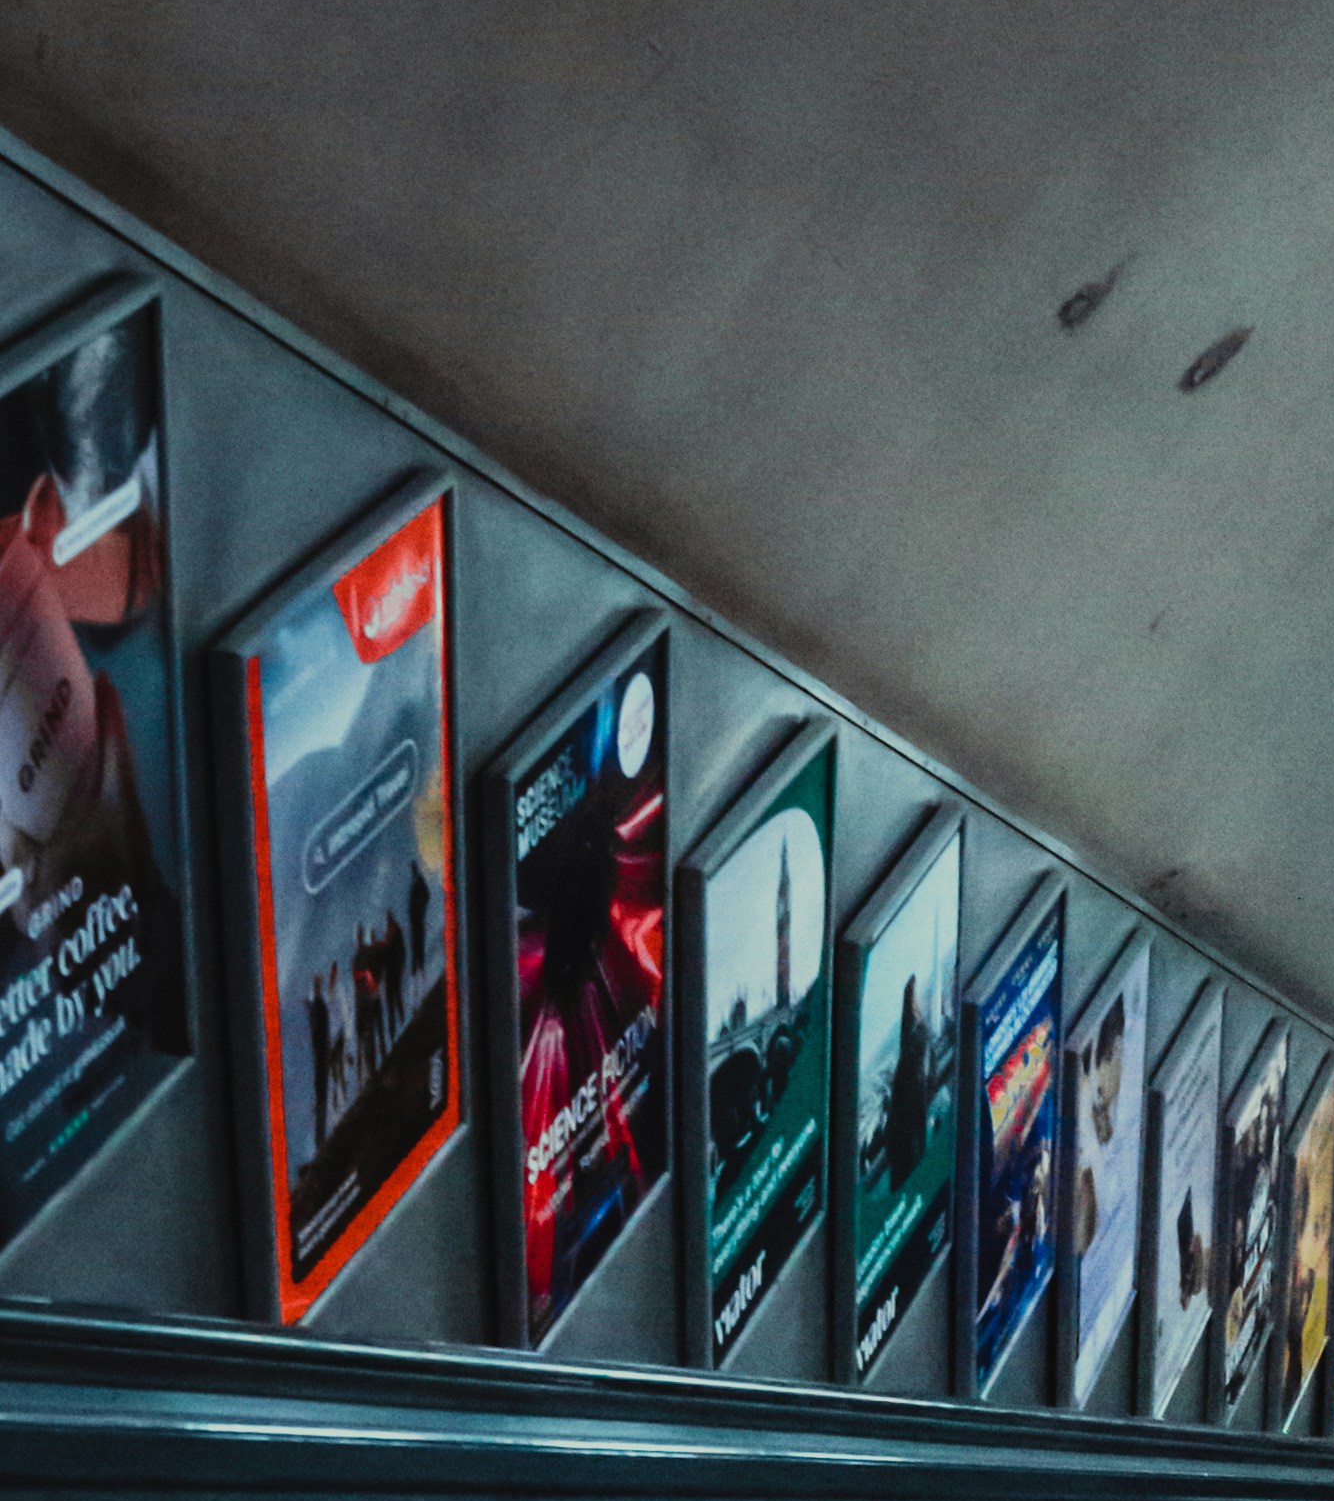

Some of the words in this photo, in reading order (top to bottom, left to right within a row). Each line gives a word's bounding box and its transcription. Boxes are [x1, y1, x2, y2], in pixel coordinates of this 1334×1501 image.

[18, 677, 71, 793] GRIND
[516, 742, 574, 826] SCIENCE
[518, 773, 587, 862] MUSEUM
[27, 875, 84, 941] GRIND
[527, 1071, 598, 1185] SCIENCE
[601, 1004, 657, 1097] FICTION
[714, 1248, 767, 1346] viator
[856, 1284, 899, 1372] viator
